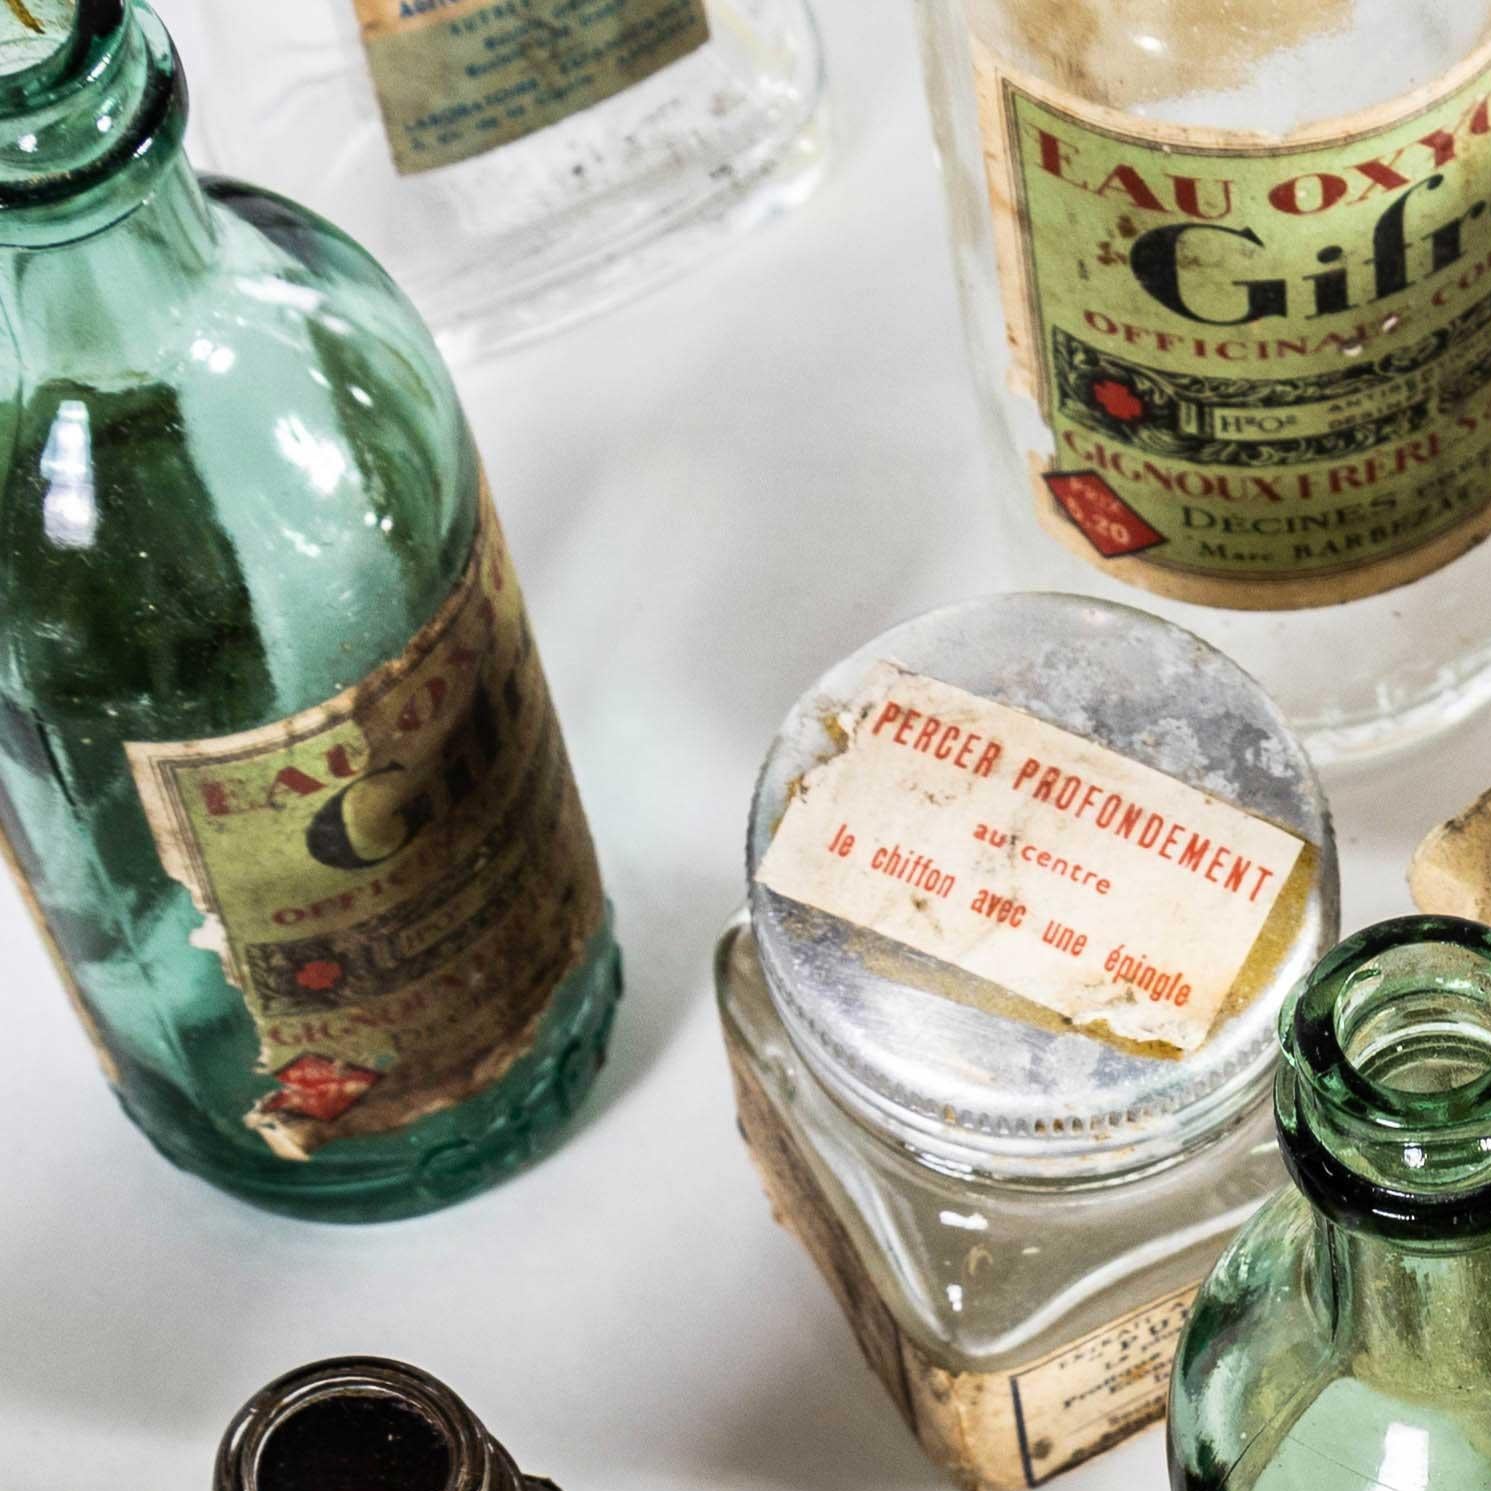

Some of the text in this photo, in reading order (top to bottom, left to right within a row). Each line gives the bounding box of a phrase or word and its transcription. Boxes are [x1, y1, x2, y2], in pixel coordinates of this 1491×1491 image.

[1030, 122, 1235, 220] EAU
[873, 701, 1274, 903] PERCER PROFONDEMENT
[973, 820, 1112, 896] au centre
[829, 824, 1193, 1009] le chiffon avec une épingle
